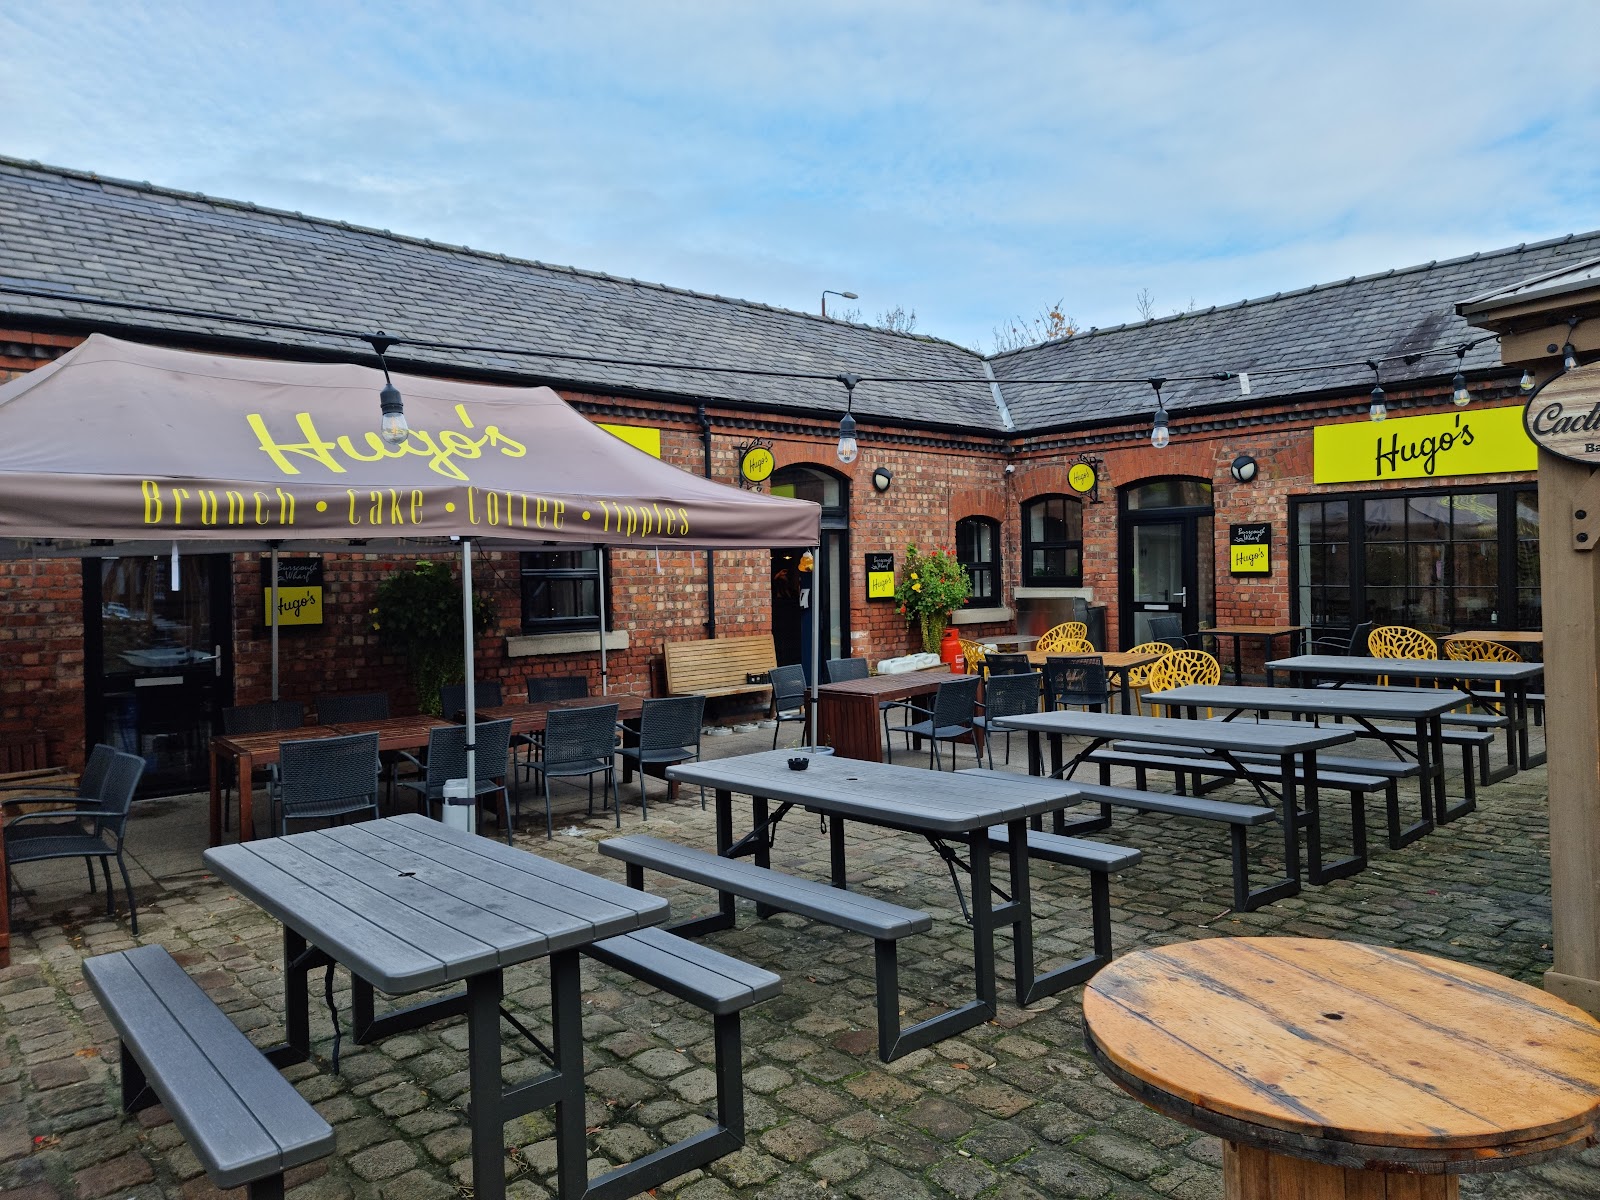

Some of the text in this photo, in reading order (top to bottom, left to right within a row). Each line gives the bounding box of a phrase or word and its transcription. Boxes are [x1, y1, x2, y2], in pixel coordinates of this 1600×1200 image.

[246, 404, 527, 481] Hugo's
[749, 451, 769, 474] Hugo's
[1375, 413, 1475, 477] Hugo's
[141, 480, 295, 525] Brunch
[346, 488, 424, 525] Cake
[597, 500, 689, 538] Tipples
[1235, 547, 1265, 567] Hugo's
[872, 574, 892, 592] Hugo's
